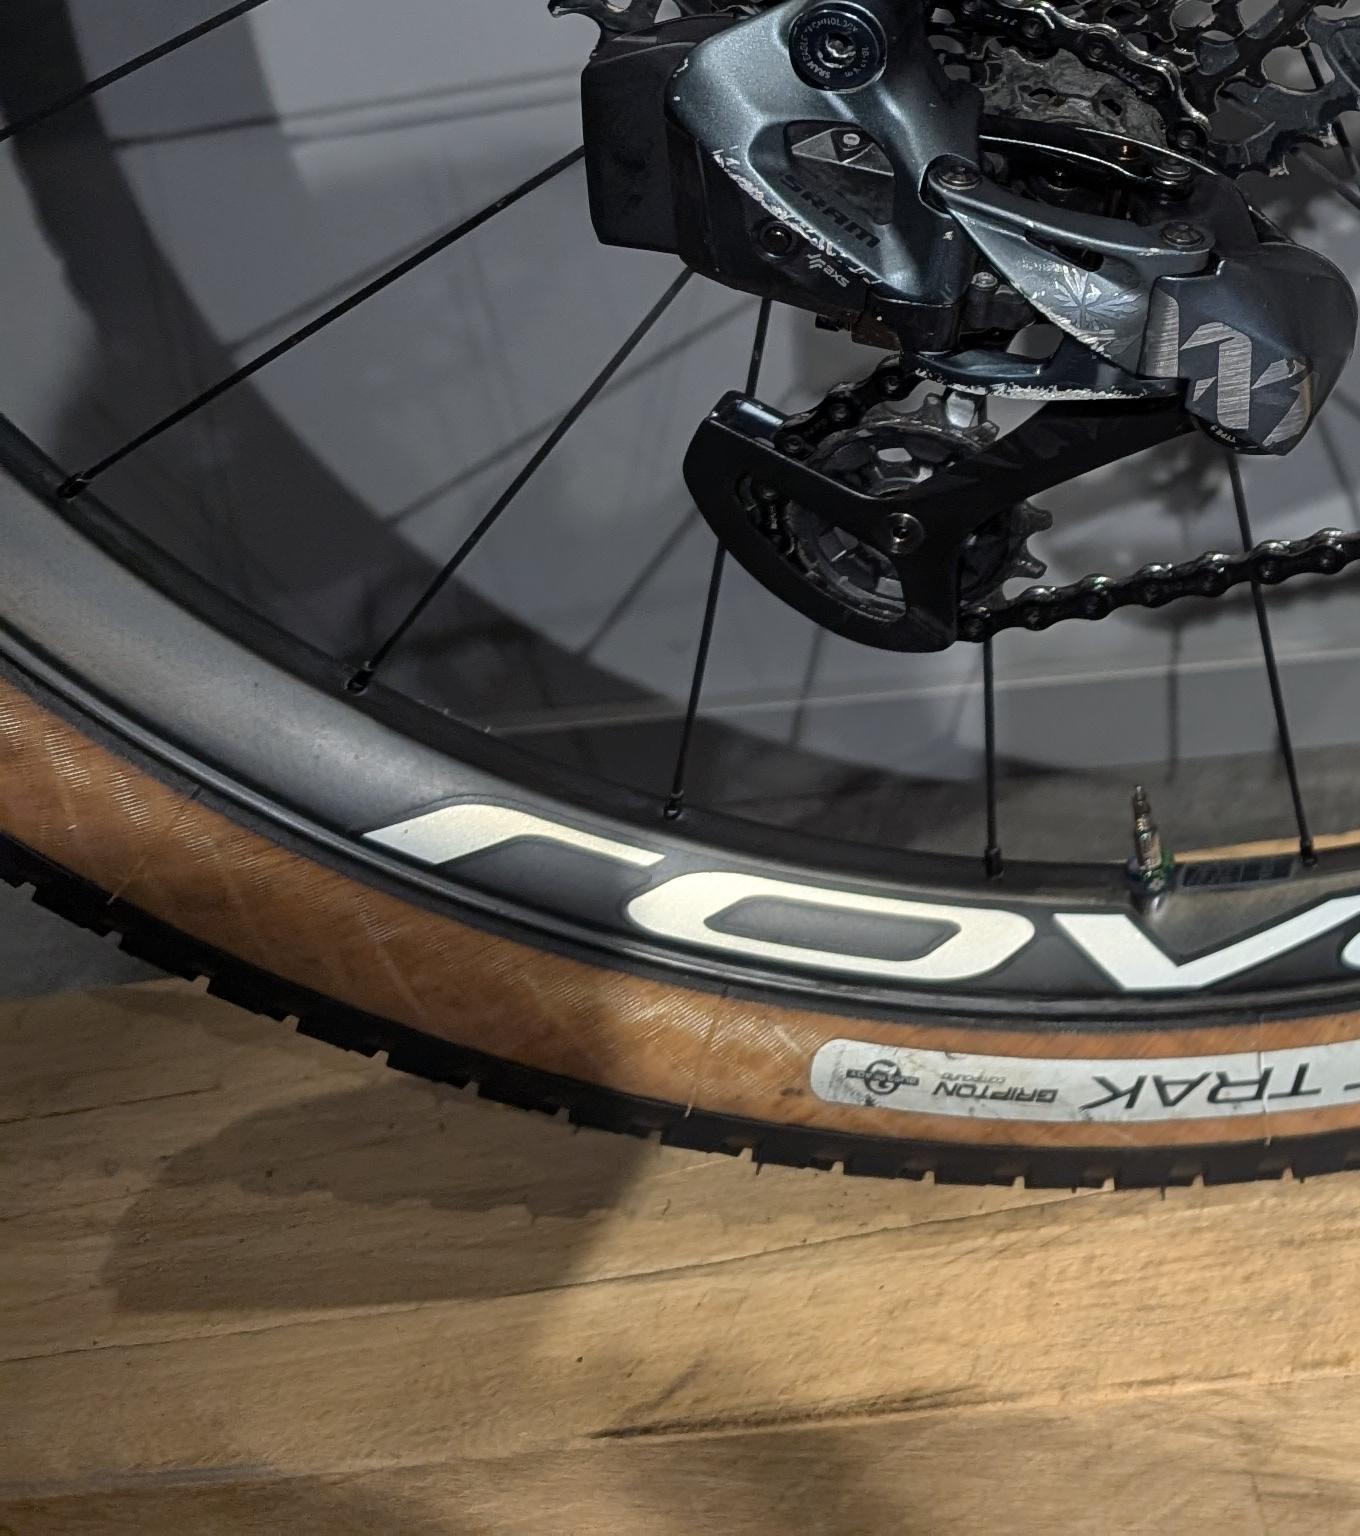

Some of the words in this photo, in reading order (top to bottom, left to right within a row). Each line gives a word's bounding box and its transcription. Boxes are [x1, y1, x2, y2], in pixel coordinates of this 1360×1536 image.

[780, 173, 881, 249] SRAM
[931, 1080, 1059, 1105] GRIPTON
[1079, 1061, 1323, 1113] TRAK
